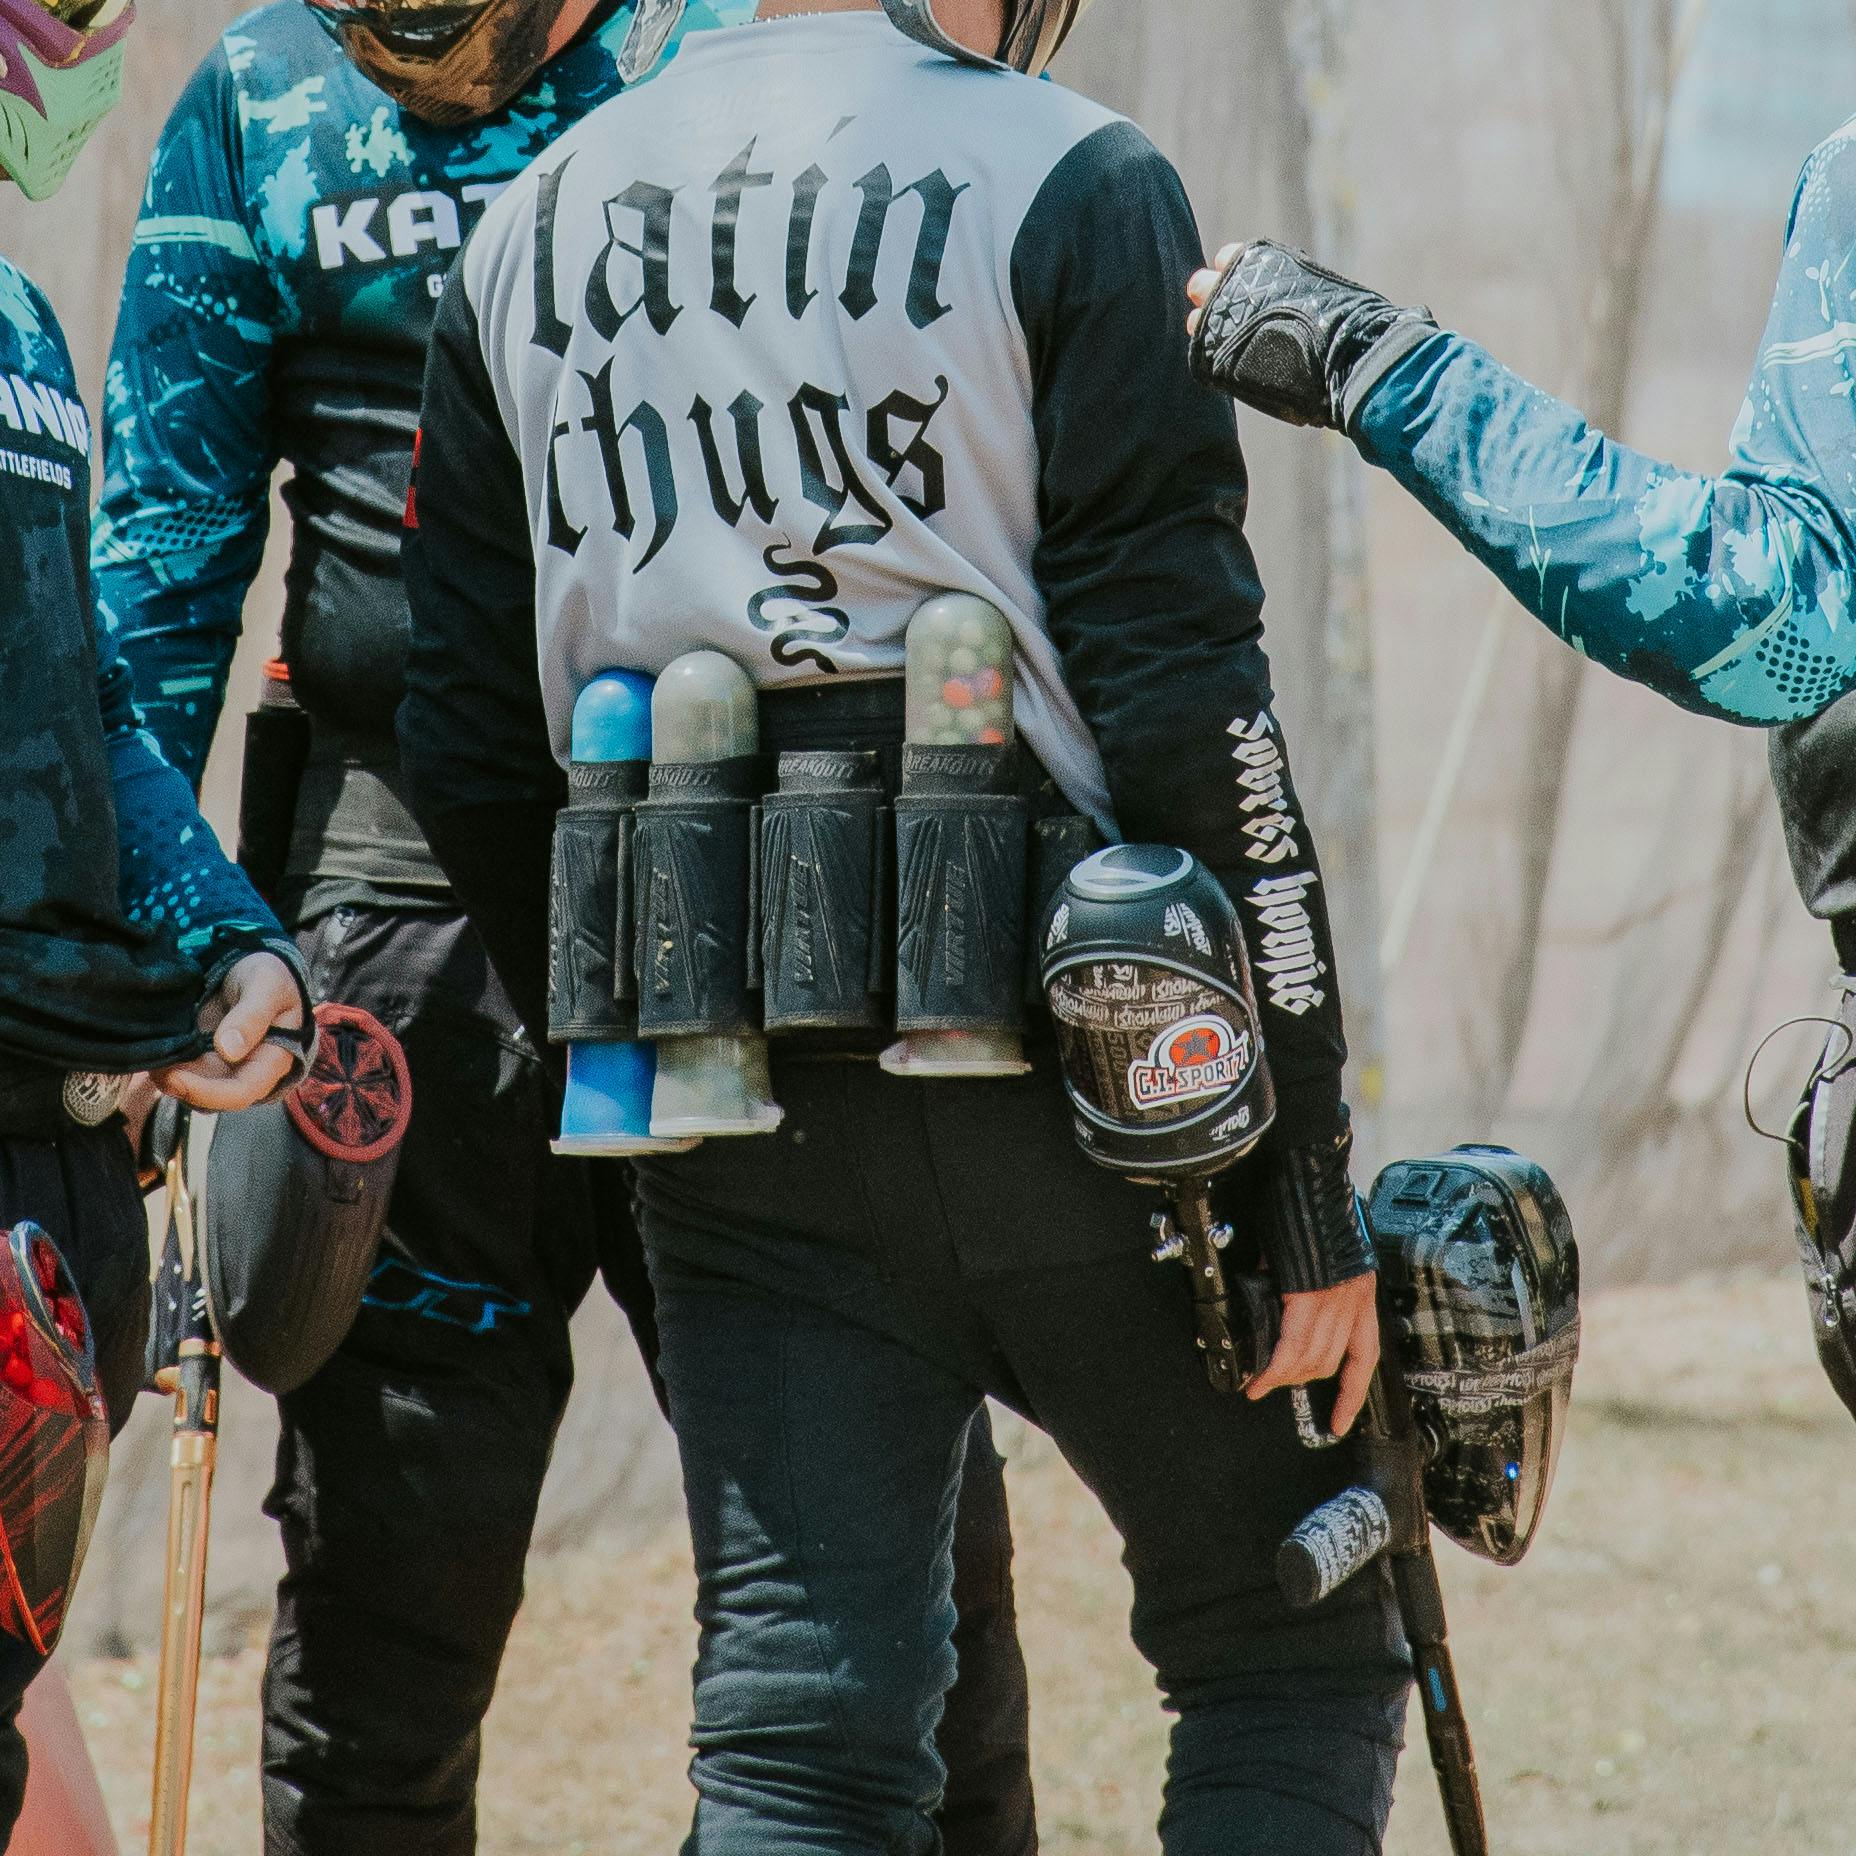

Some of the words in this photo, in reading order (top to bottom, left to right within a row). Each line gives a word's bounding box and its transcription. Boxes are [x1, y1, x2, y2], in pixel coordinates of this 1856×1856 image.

[529, 116, 971, 360] latin
[546, 354, 949, 574] thugs
[1244, 870, 1327, 1016] homie
